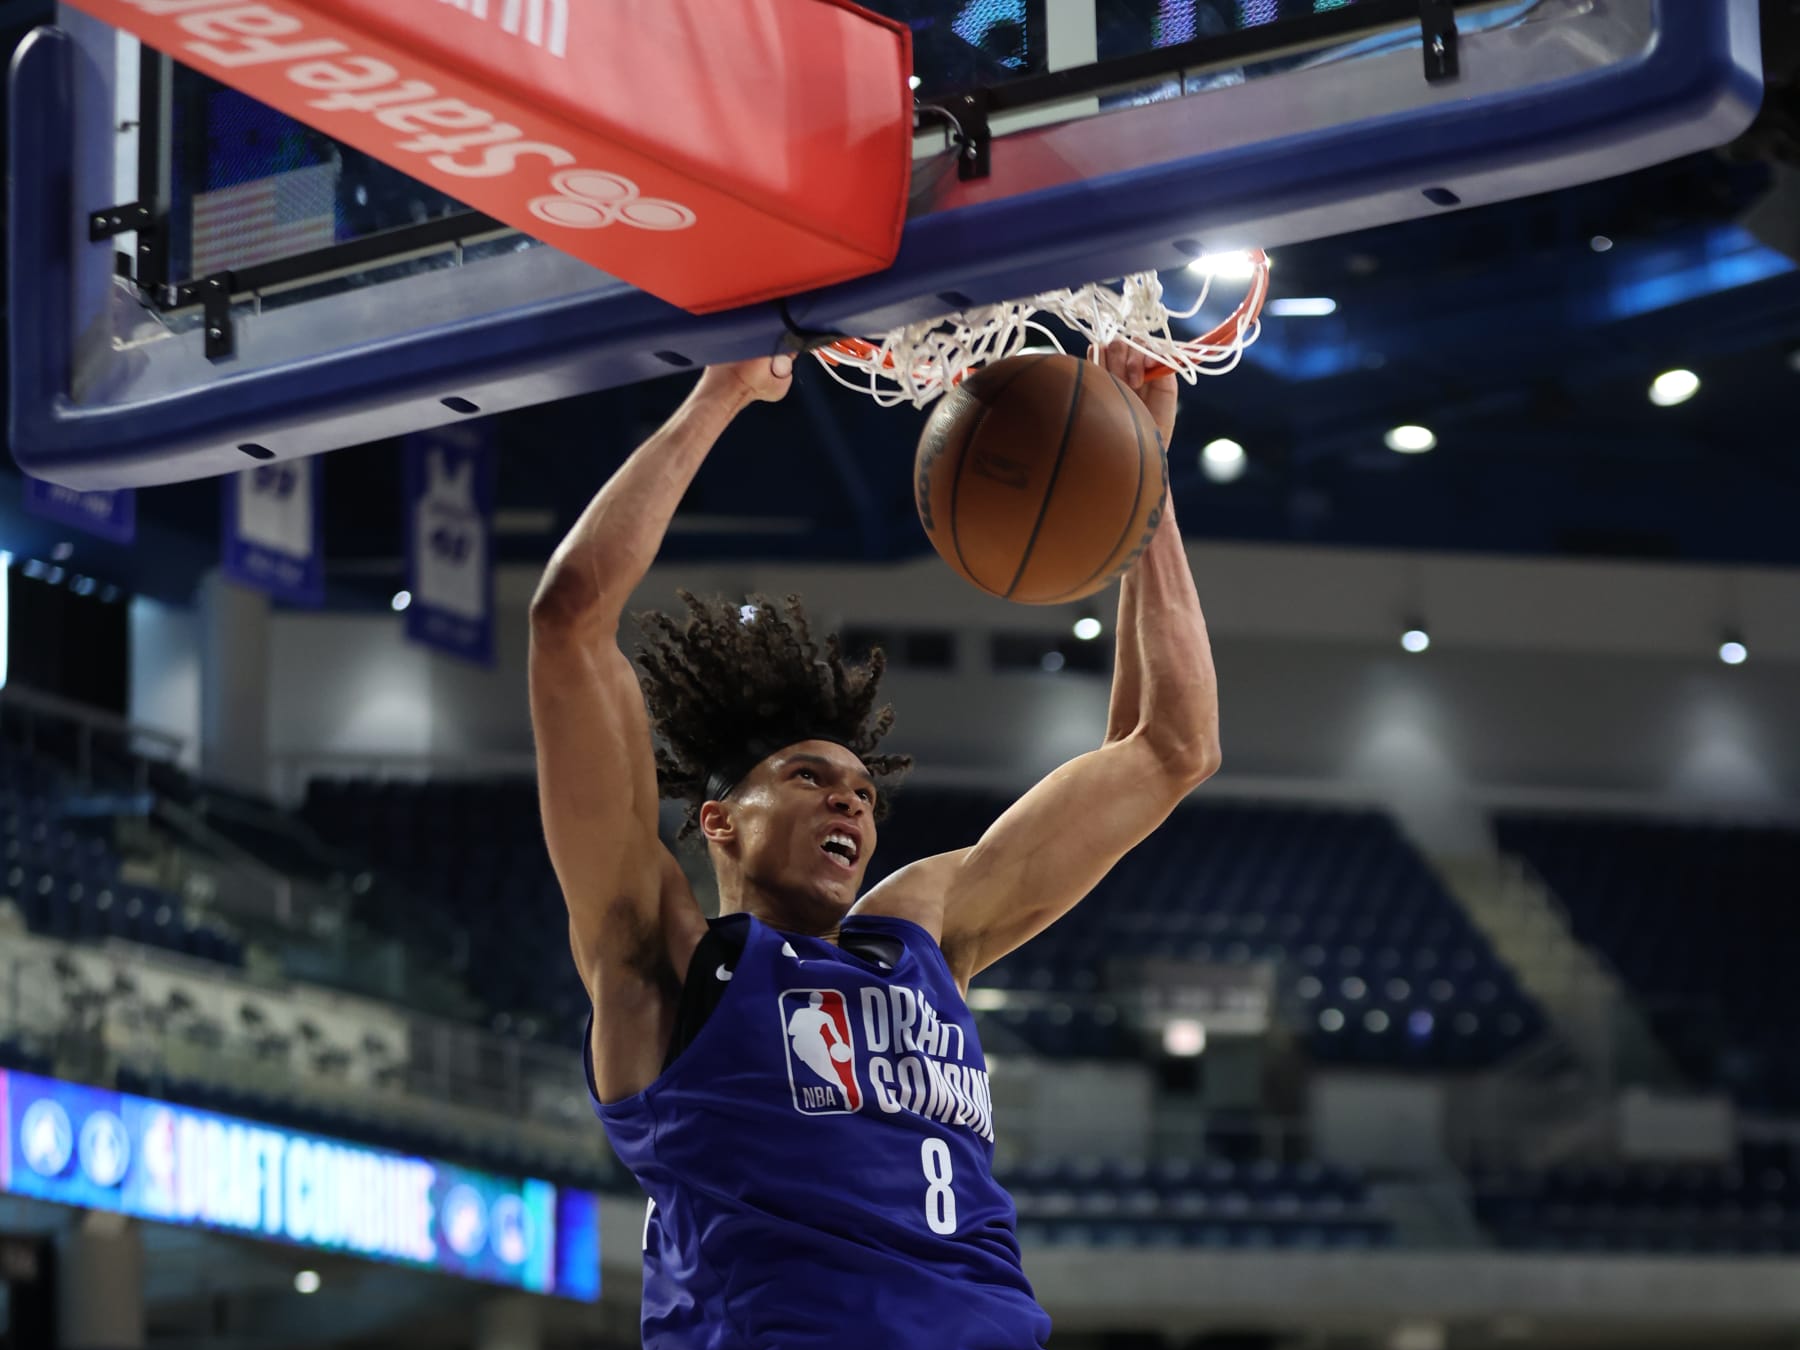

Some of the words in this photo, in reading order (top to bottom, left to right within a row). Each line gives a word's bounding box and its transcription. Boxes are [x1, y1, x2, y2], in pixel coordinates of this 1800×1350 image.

[802, 1086, 836, 1109] NBA
[868, 1056, 995, 1144] COMBIN
[921, 1137, 956, 1235] 8
